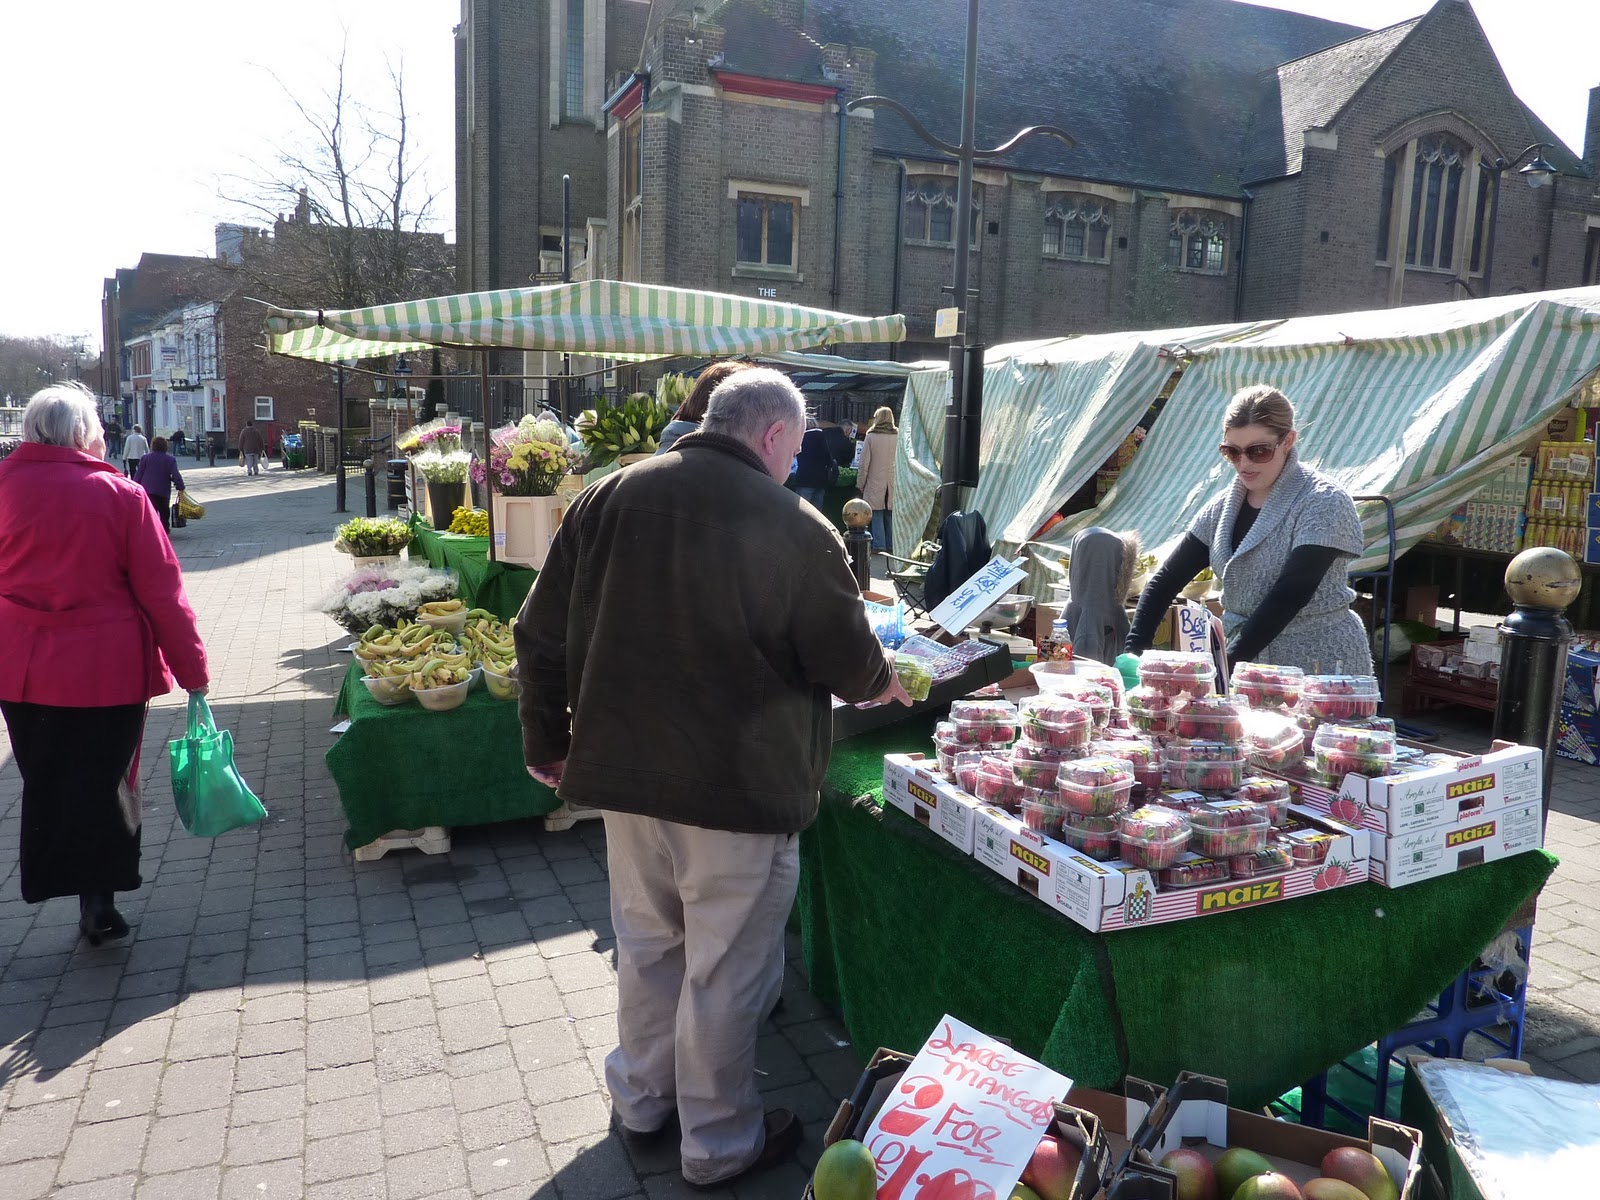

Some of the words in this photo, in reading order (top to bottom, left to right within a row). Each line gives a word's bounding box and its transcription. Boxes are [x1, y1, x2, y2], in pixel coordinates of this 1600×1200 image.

[758, 287, 777, 297] THE
[909, 783, 936, 806] naiz
[1450, 776, 1493, 797] naiz
[1459, 809, 1481, 821] plaform
[1449, 823, 1493, 845] naiz
[1012, 843, 1049, 873] naiz
[1202, 880, 1281, 910] naiz
[926, 1023, 1039, 1077] LARGE
[932, 1102, 1002, 1153] FOR
